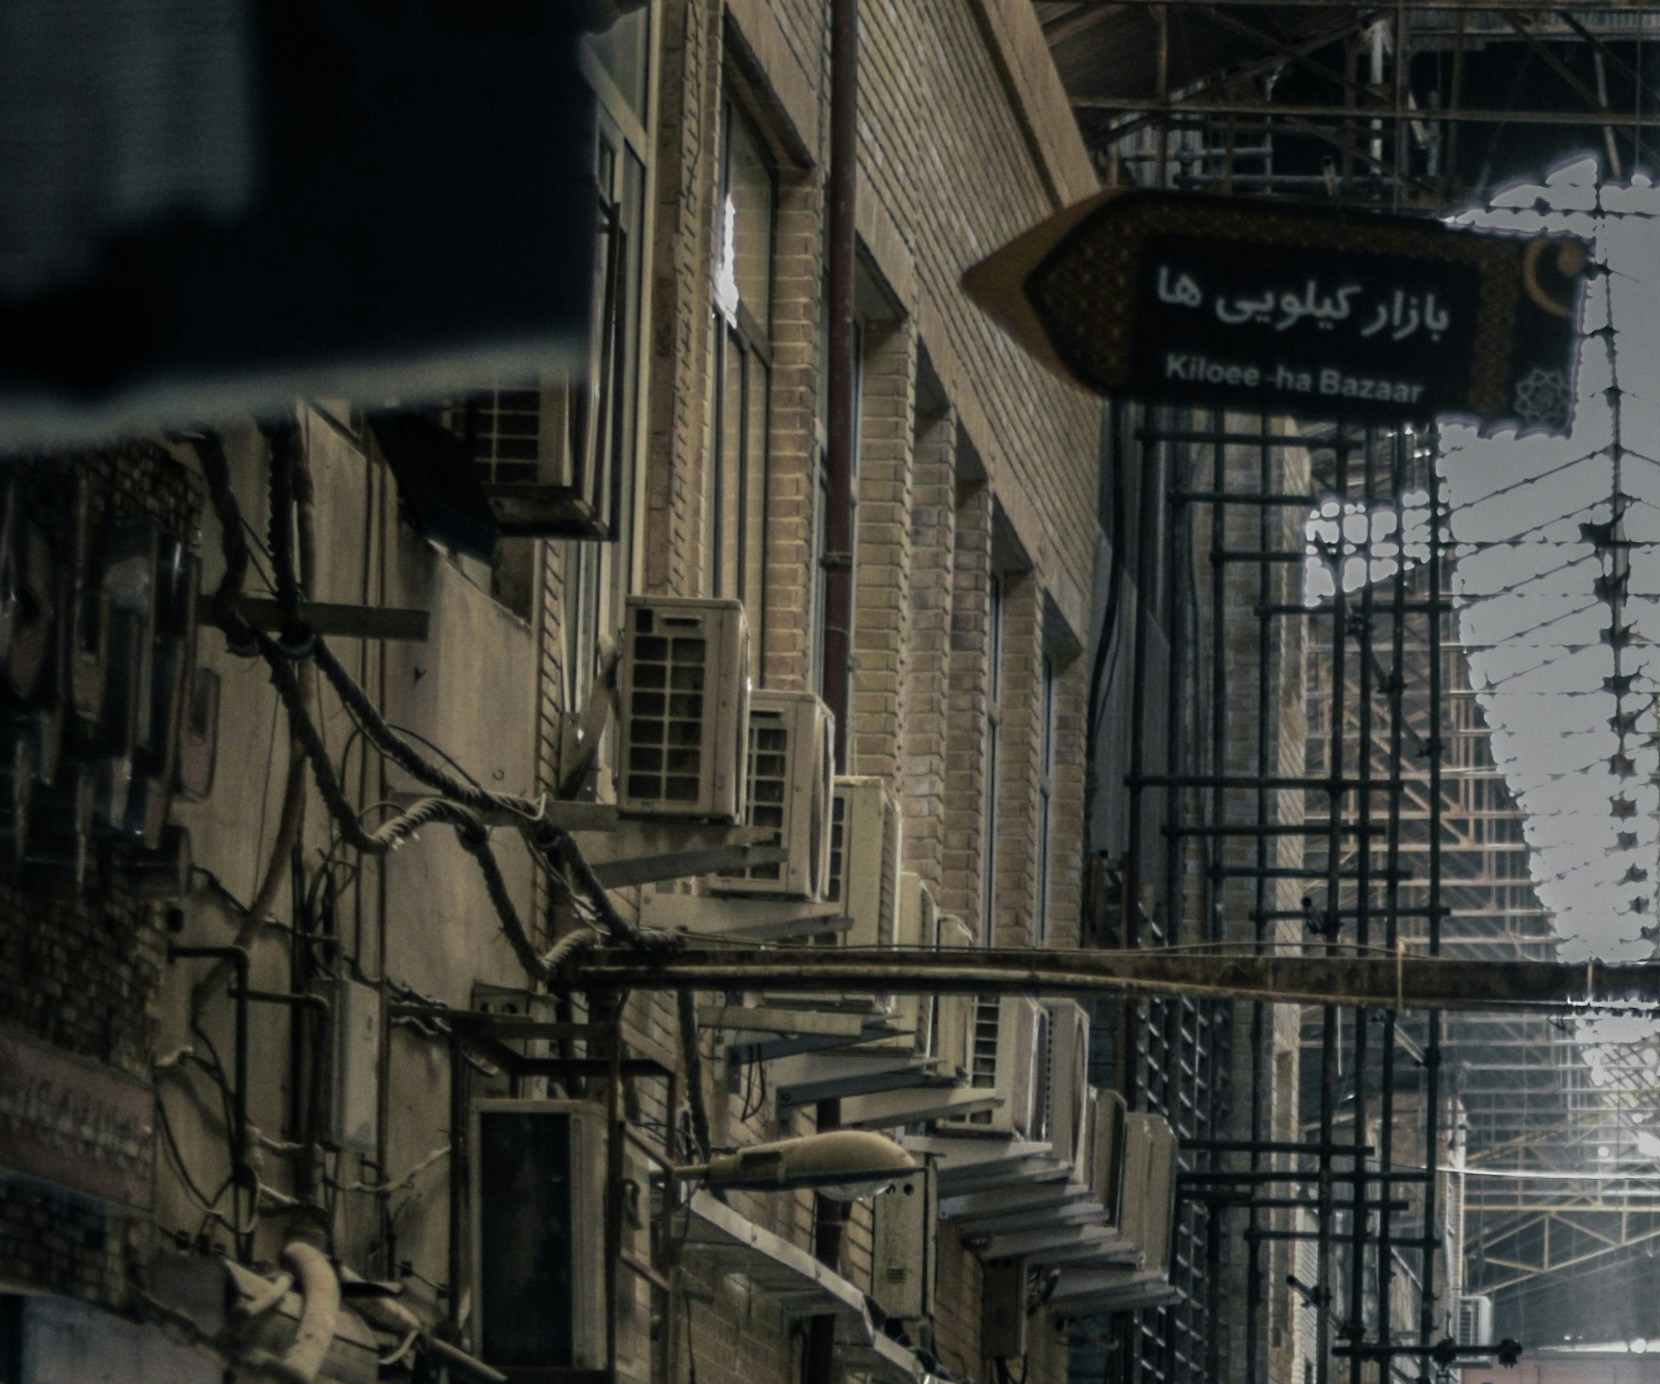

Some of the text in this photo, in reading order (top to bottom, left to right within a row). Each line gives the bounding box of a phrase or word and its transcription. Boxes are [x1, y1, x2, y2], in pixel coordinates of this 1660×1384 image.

[1156, 264, 1450, 342] بازار کیلویی ها
[1164, 352, 1261, 388] Kiloee
[1317, 367, 1425, 404] Bazaar
